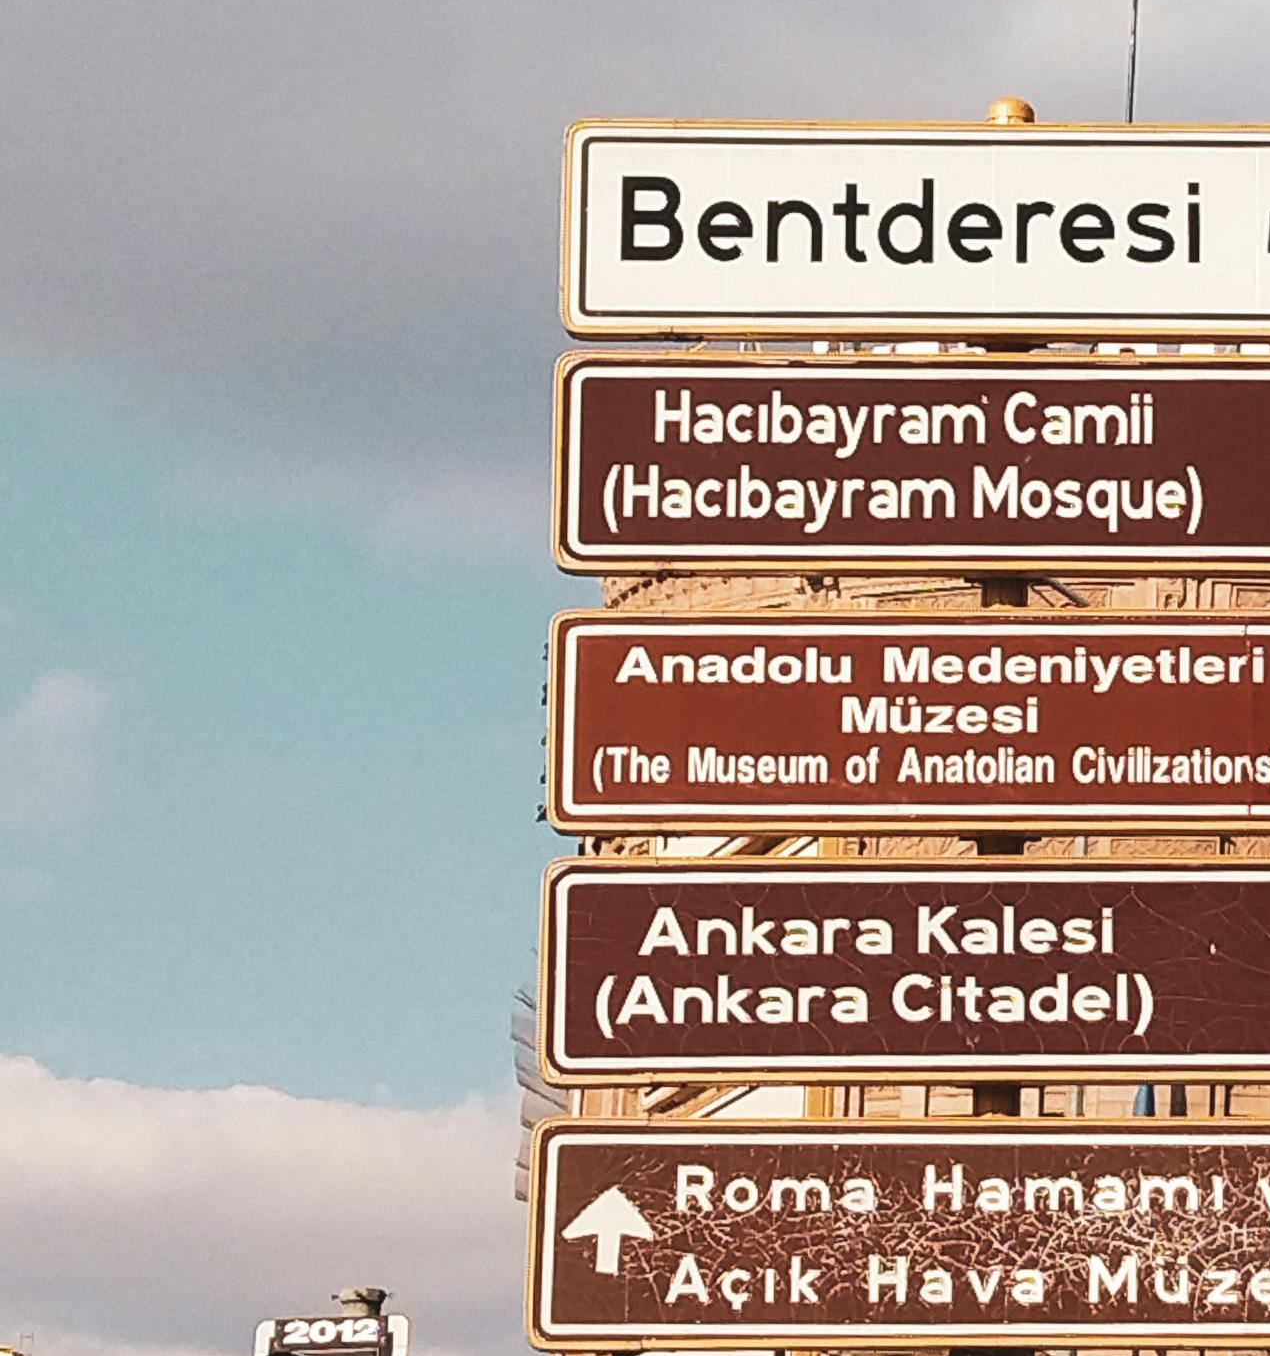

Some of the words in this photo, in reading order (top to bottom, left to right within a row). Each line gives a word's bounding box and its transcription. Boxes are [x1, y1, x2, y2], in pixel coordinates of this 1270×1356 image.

[621, 177, 1200, 264] Bentderesi
[655, 390, 985, 458] Hacıbayram
[1005, 392, 1152, 445] Camii
[604, 466, 955, 533] (Hacıbayram
[974, 466, 1203, 533] Mosque)
[616, 647, 851, 683] Anadolu
[884, 647, 1263, 690] Medeniyetleri
[842, 697, 1037, 733] Müzesi
[594, 747, 669, 792] (The
[688, 747, 827, 783] Museum
[846, 747, 879, 783] of
[898, 748, 1054, 783] Anatolian
[639, 908, 892, 955] Ankara
[919, 906, 1112, 954] Kalesi
[597, 976, 867, 1038] (Ankara
[893, 974, 1152, 1035] Citadel)
[675, 1164, 876, 1213] Roma
[923, 1164, 1225, 1213] Hamamı
[665, 1252, 822, 1310] Açık
[868, 1253, 1046, 1305] Hava
[282, 1318, 379, 1345] 2012
